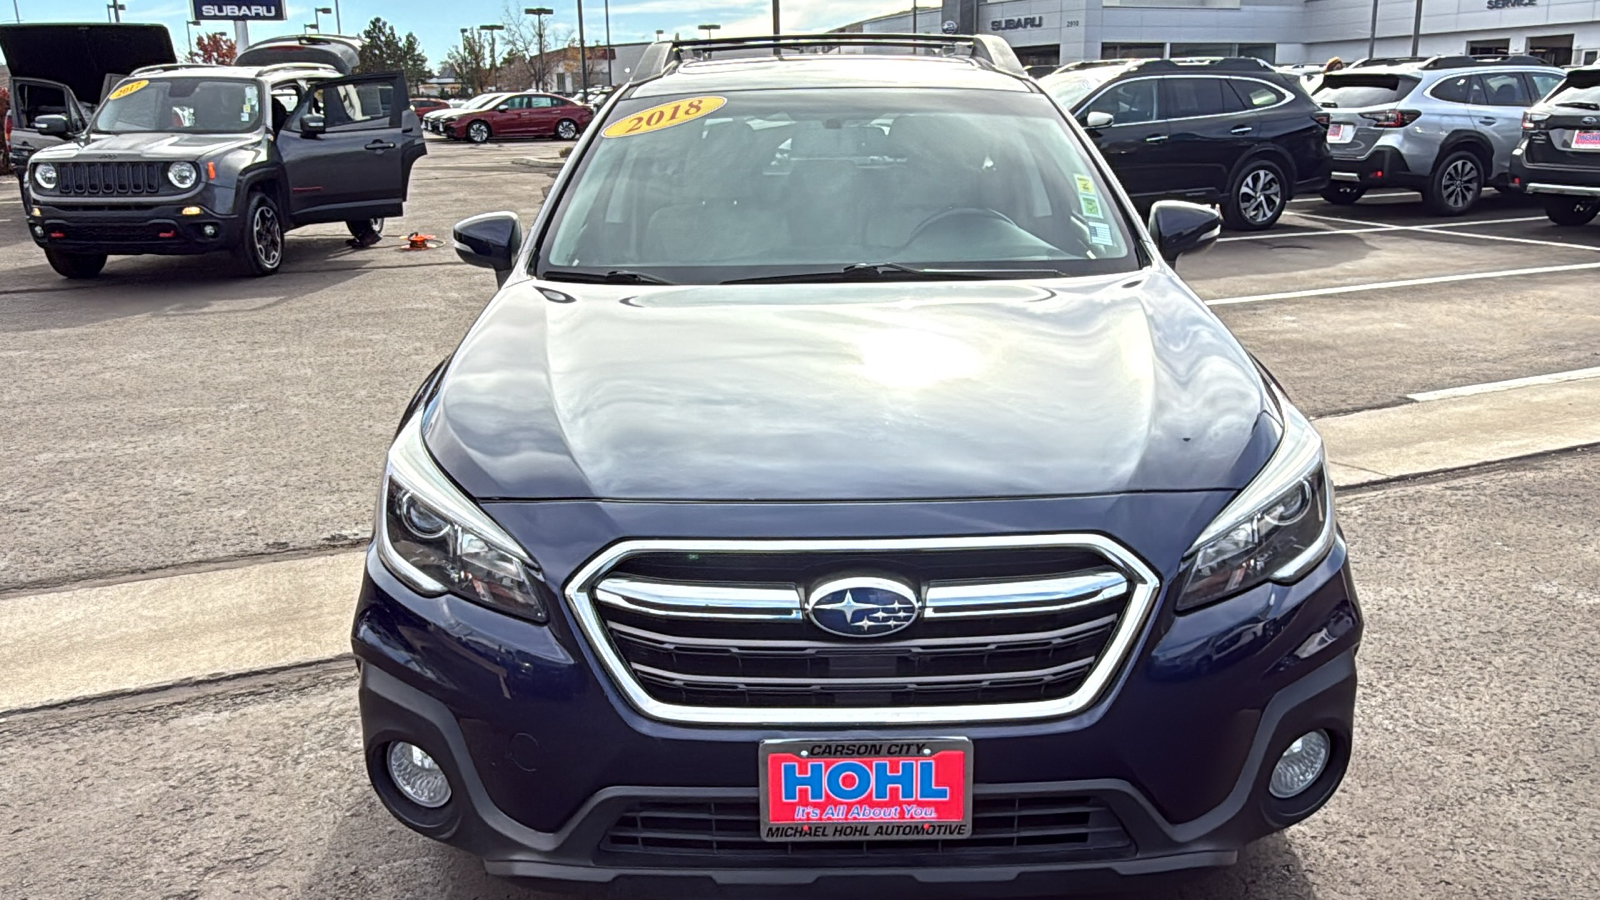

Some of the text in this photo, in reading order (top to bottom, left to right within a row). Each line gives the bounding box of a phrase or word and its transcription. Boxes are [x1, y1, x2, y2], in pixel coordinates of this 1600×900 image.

[201, 5, 276, 17] SUBARU
[1486, 0, 1537, 10] SERVICE
[990, 16, 1043, 31] SUBARU
[625, 99, 703, 134] 2018
[810, 743, 926, 756] CARSON CITY
[781, 761, 949, 802] HOHL
[795, 806, 820, 819] It's
[822, 804, 847, 819] All
[848, 804, 899, 819] About
[766, 824, 967, 838] MICHAEL HOHL AUTOMOTIVE
